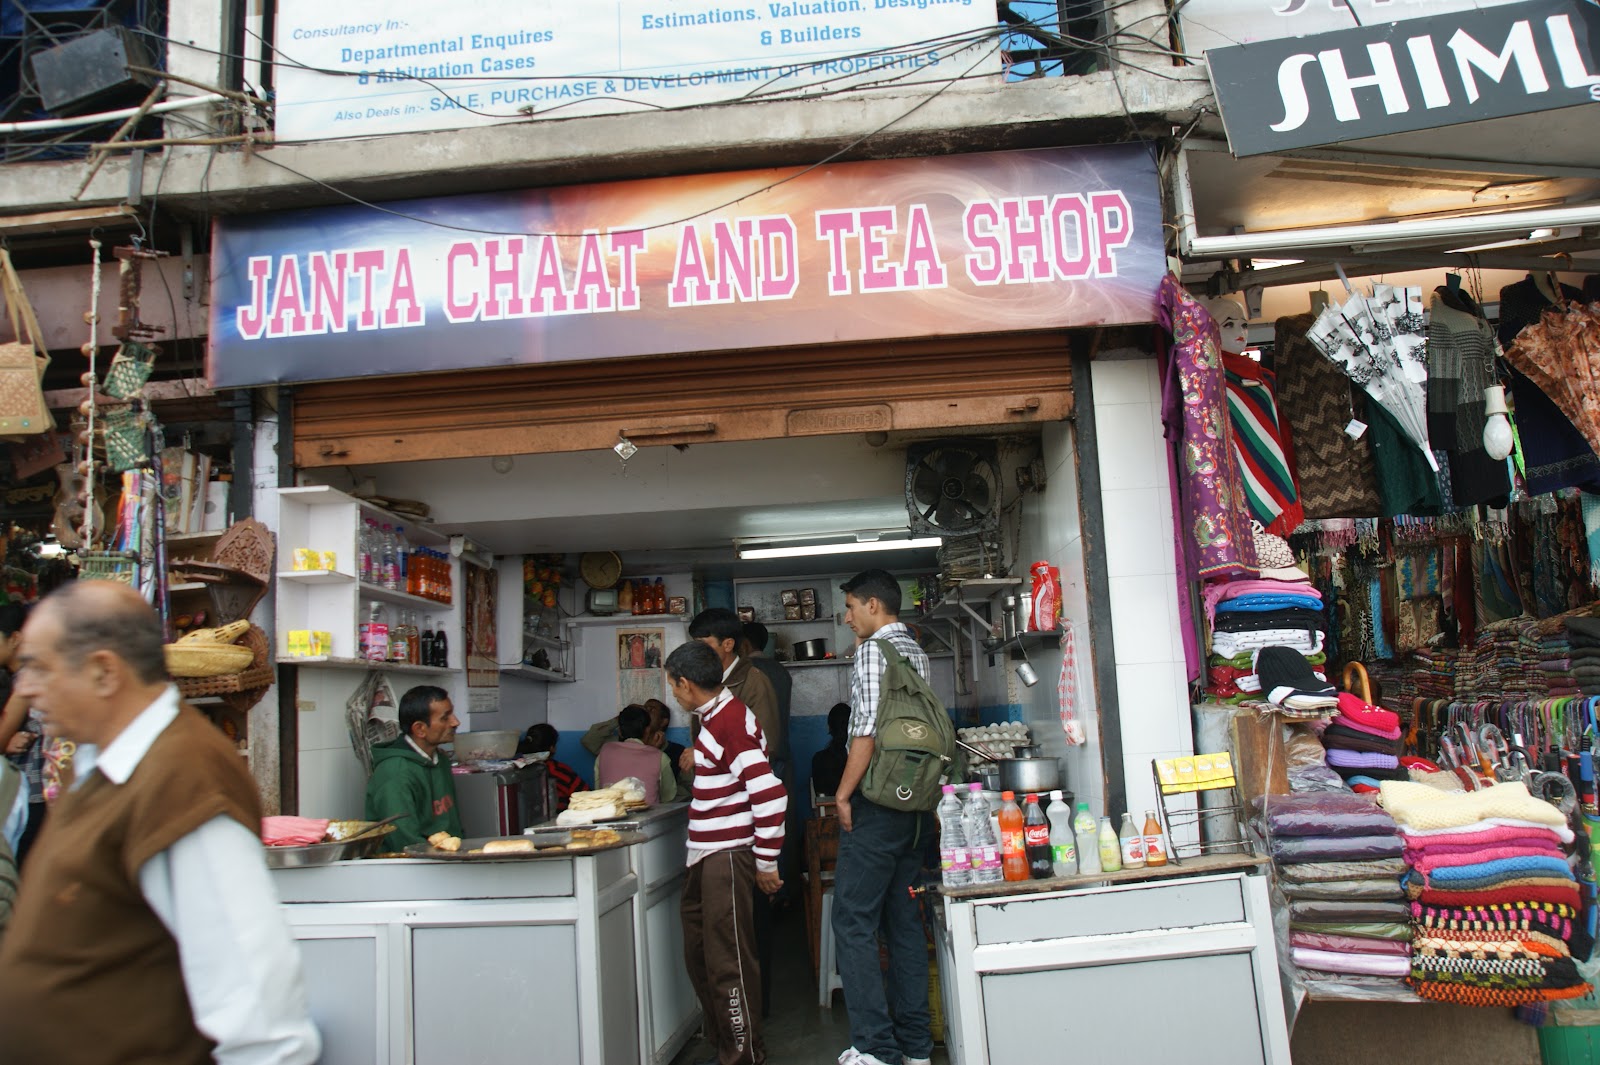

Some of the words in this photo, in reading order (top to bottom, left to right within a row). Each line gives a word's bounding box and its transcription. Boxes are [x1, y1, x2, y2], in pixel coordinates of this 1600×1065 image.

[292, 20, 383, 41] Consultancy
[760, 30, 773, 46] &
[780, 25, 862, 45] Builders
[341, 36, 464, 64] Departmental
[471, 29, 554, 51] Enquires
[376, 60, 474, 84] Arbitration
[481, 56, 536, 73] Cases
[334, 109, 363, 122] Also
[364, 107, 401, 119] Deals
[430, 94, 485, 113] SALE,
[490, 81, 598, 106] PURCHASE
[604, 79, 618, 94] &
[623, 64, 772, 93] DEVELOPMENT
[779, 64, 803, 79] OF
[811, 51, 941, 76] PROPERTIES
[236, 245, 425, 341] JANTA
[442, 224, 650, 325] CHAAT
[667, 213, 800, 308] AND
[815, 202, 948, 297] TEA
[961, 189, 1135, 287] SHOP
